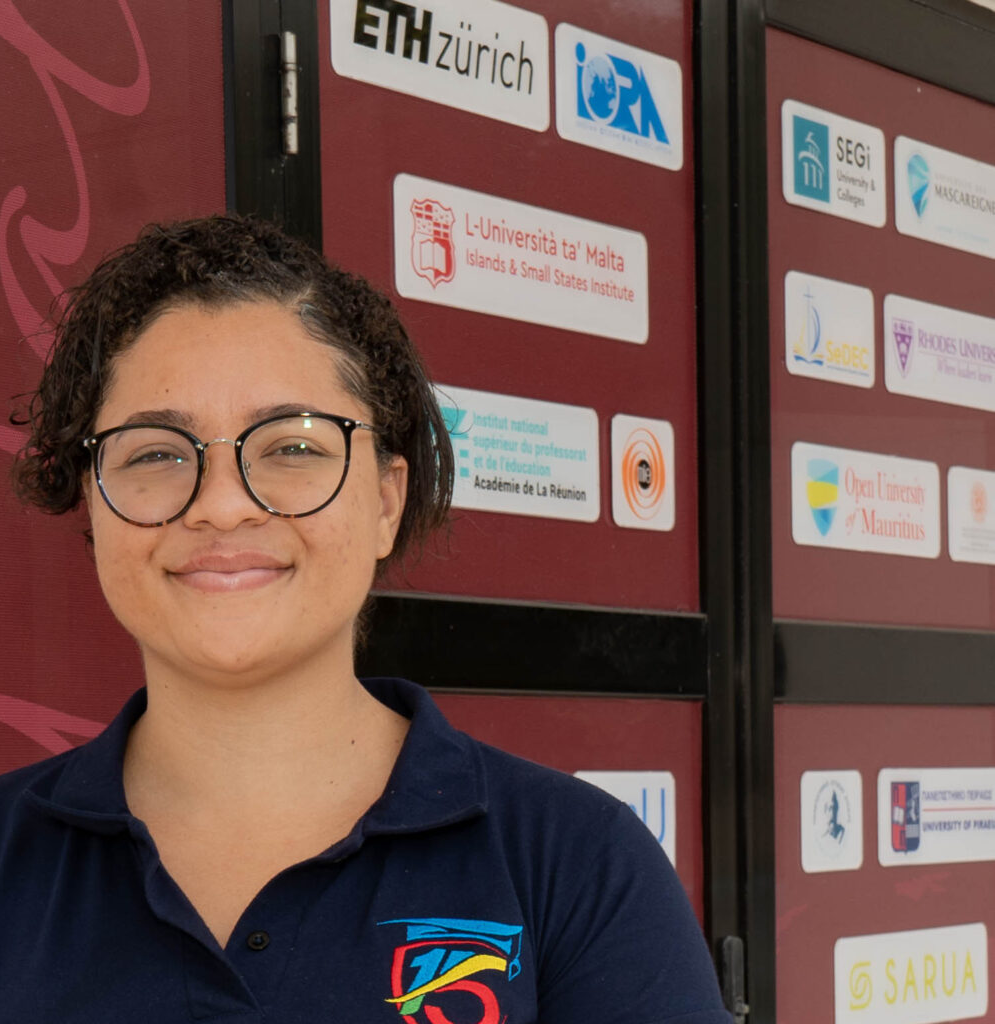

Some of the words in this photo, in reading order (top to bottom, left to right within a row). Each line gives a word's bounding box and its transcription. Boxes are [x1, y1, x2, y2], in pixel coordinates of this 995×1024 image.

[836, 136, 871, 170] SEGi
[837, 169, 869, 192] University
[870, 178, 876, 191] &
[837, 187, 865, 208] Colleges
[466, 213, 558, 256] L-Università
[562, 240, 581, 261] ta'
[586, 246, 625, 273] Malta
[466, 248, 506, 273] Islands
[509, 258, 517, 275] &
[521, 262, 551, 284] Small
[554, 269, 588, 292] States
[591, 277, 635, 303] Institute
[825, 340, 869, 370] SeDEC
[918, 328, 957, 355] RHODES
[473, 413, 508, 431] Institut
[511, 418, 548, 435] national
[473, 434, 519, 453] supérieur
[521, 438, 533, 453] du
[535, 442, 587, 462] professorat
[474, 457, 482, 469] et
[484, 456, 497, 471] de
[474, 475, 521, 494] Académie
[523, 481, 535, 496] de
[537, 482, 548, 497] La
[551, 484, 587, 502] Réunion
[845, 467, 875, 504] Open
[877, 471, 925, 512] University
[845, 508, 860, 536] of
[861, 508, 926, 540] Mauritius
[923, 820, 962, 831] UNIVERSITY
[963, 819, 972, 830] OF
[884, 951, 977, 1006] SARUA
